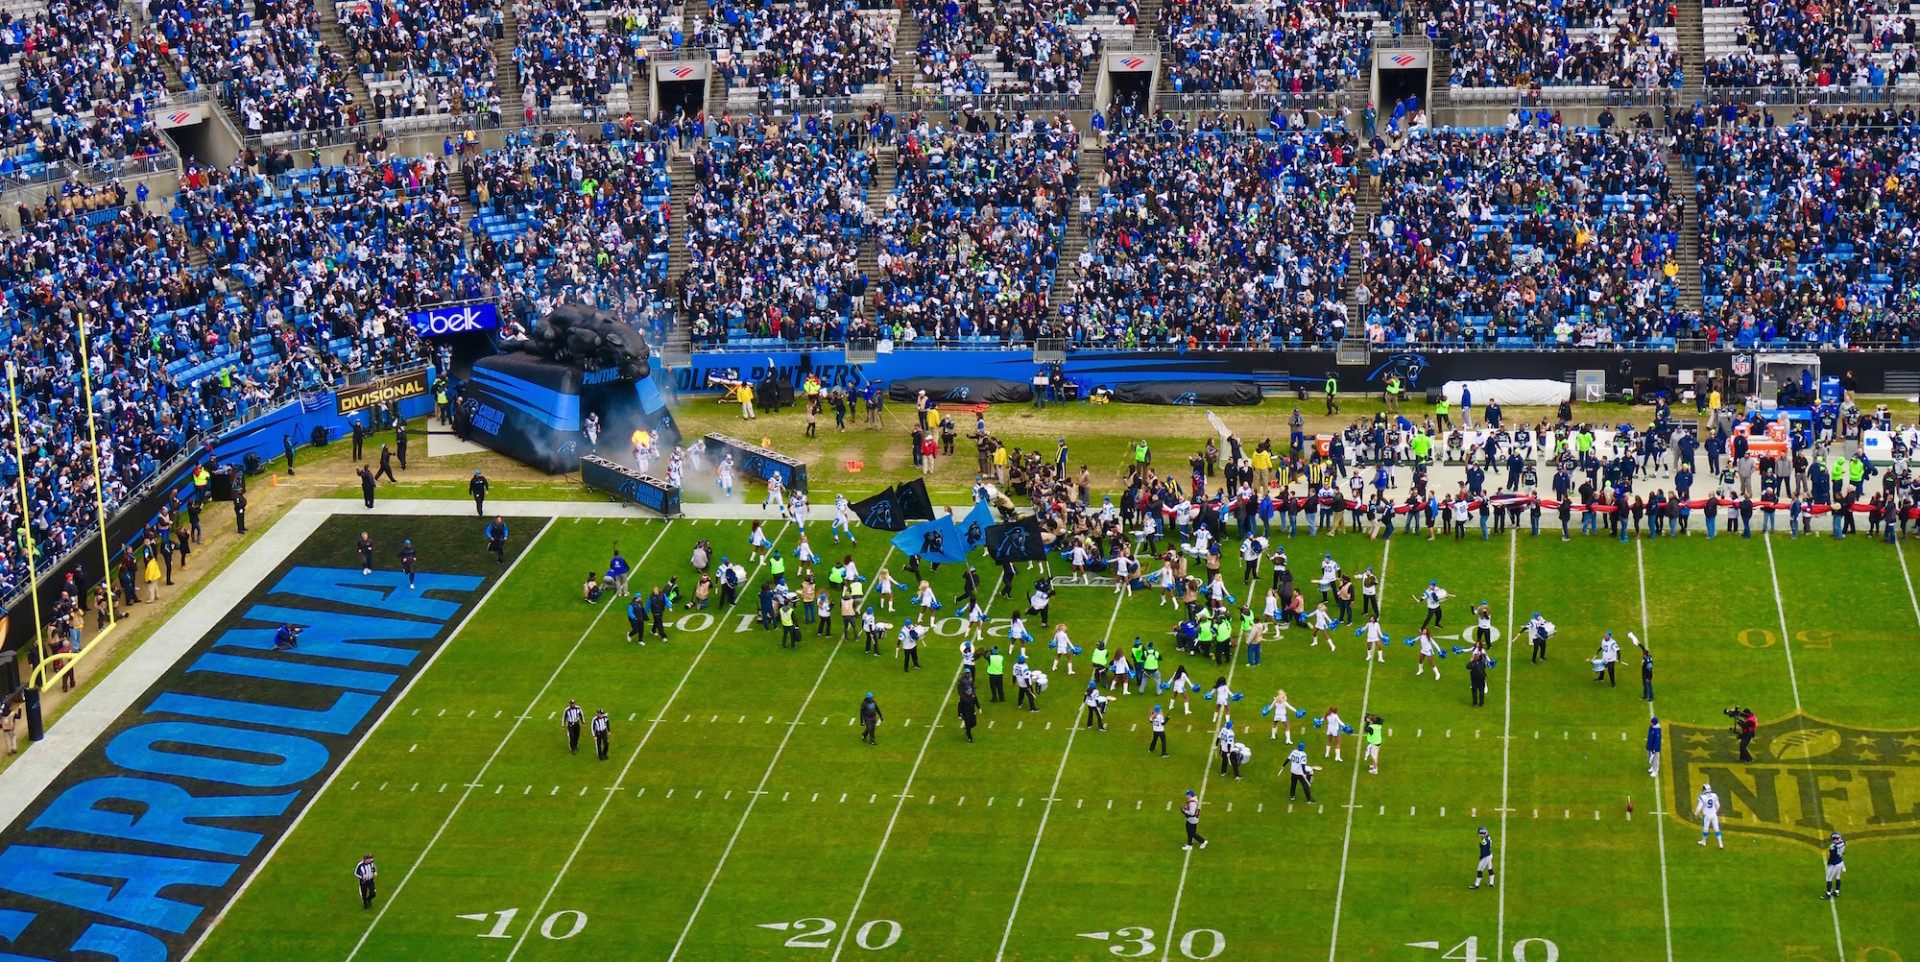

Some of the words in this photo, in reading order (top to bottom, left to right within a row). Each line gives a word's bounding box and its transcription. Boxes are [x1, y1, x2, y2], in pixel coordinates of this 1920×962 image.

[429, 307, 483, 334] belk
[583, 366, 620, 385] PANTHE
[751, 364, 862, 388] PNTHERS
[341, 380, 424, 411] DIVISIONAL
[1384, 450, 1392, 459] 51
[676, 613, 758, 633] 10
[1699, 766, 1920, 832] NFL
[1707, 799, 1713, 809] 9
[476, 908, 589, 940] 10
[783, 917, 902, 950] 20
[1108, 926, 1226, 959] 30
[1441, 936, 1559, 962] 40
